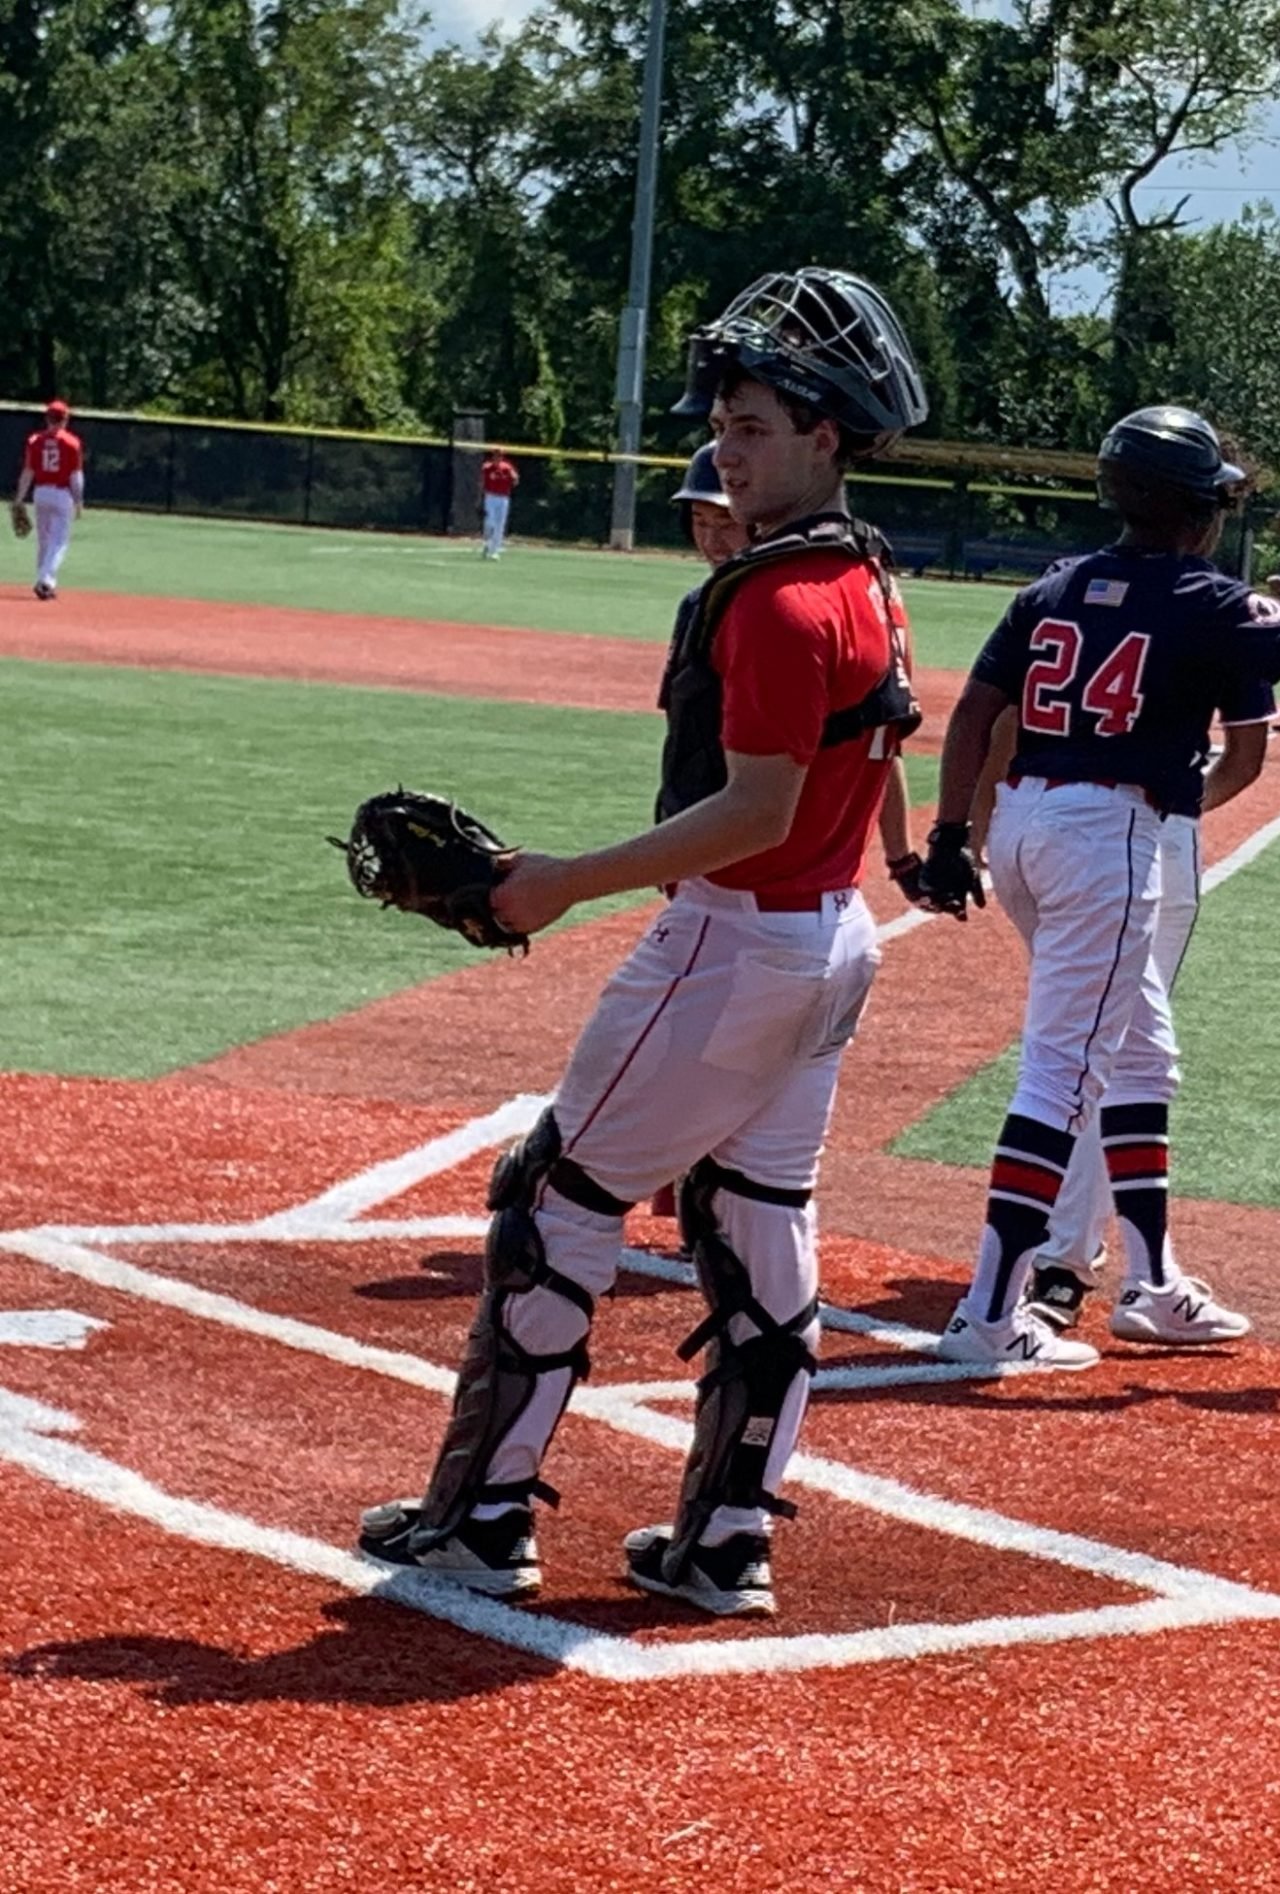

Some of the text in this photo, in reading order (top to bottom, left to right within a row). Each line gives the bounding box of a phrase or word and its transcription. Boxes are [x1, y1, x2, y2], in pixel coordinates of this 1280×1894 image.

[42, 449, 60, 471] 12
[1022, 617, 1151, 737] 24
[1119, 1289, 1142, 1306] B
[1172, 1293, 1204, 1323] N
[1005, 1332, 1042, 1360] N
